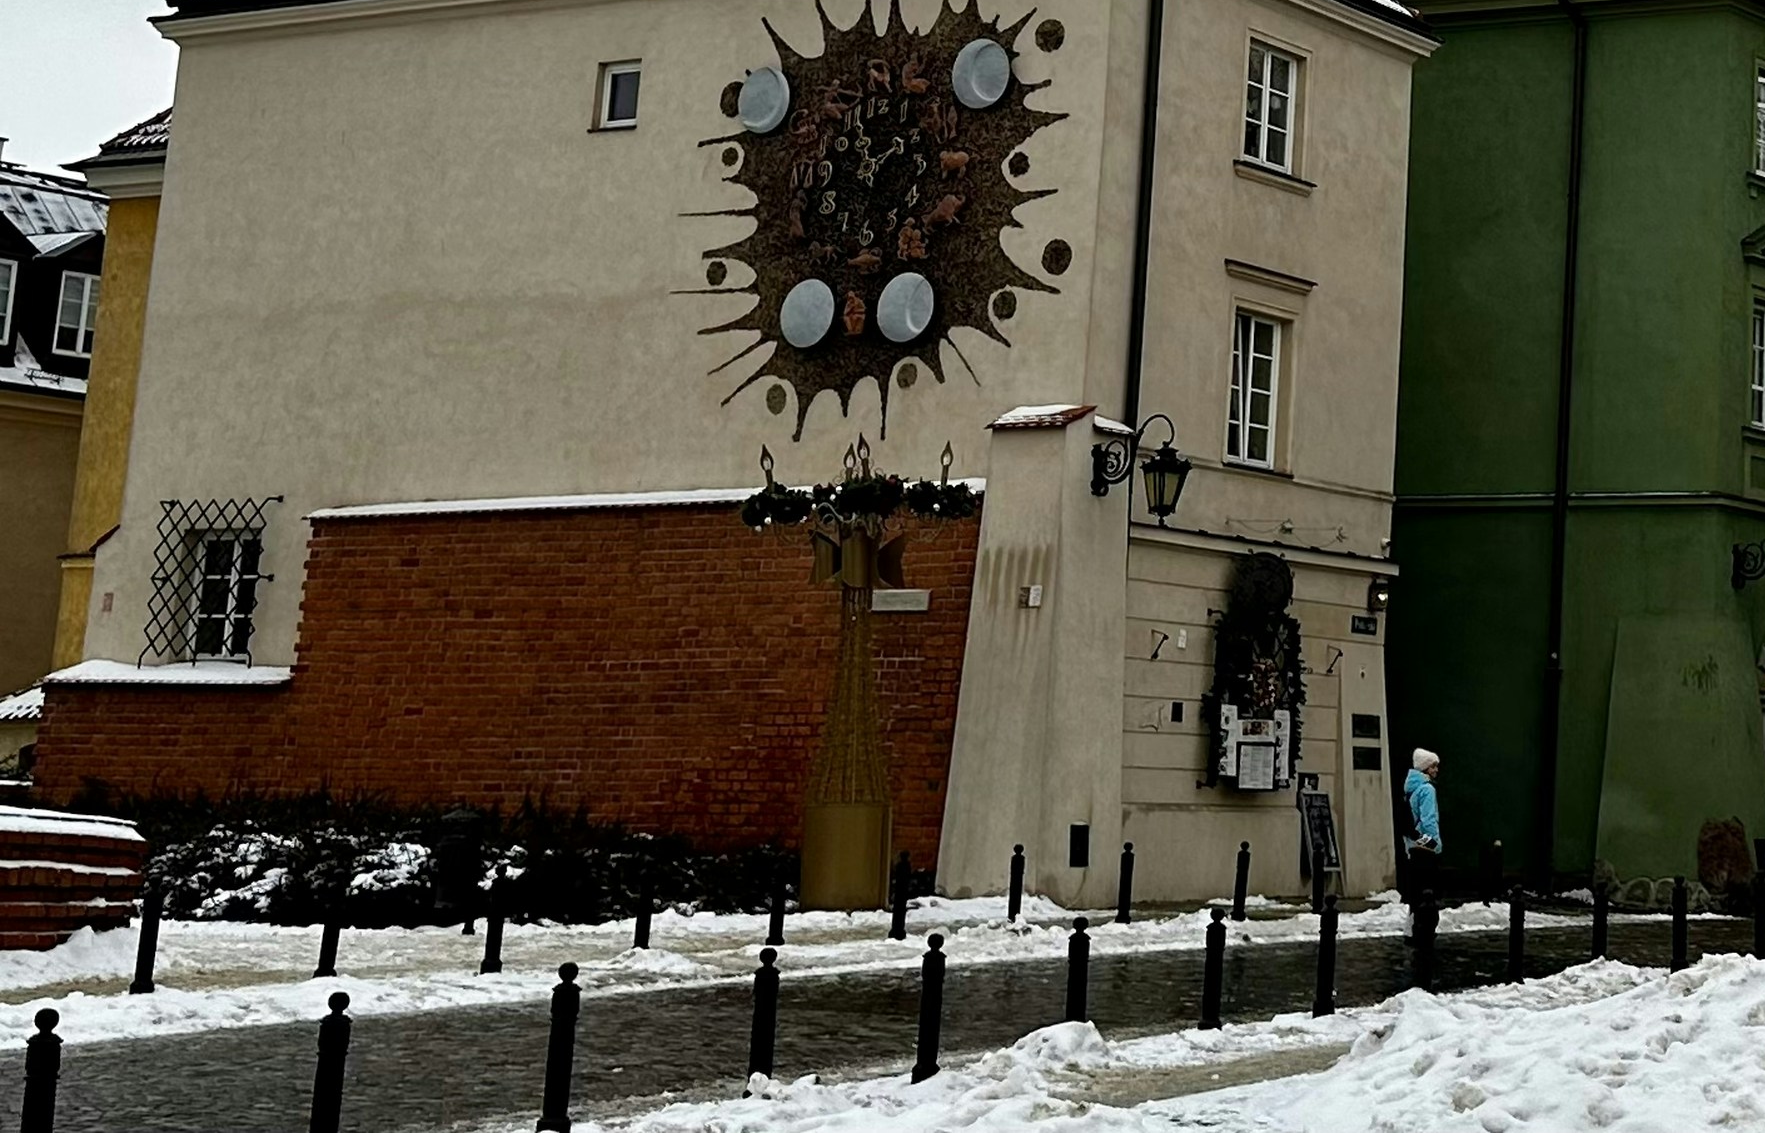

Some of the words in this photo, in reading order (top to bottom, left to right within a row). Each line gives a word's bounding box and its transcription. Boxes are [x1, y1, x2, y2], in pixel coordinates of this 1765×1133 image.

[866, 97, 890, 119] 12
[900, 98, 909, 124] 1
[818, 160, 833, 187] 9
[913, 153, 927, 176] 3
[818, 190, 836, 215] 8
[904, 183, 920, 209] 4
[838, 211, 849, 232] 7
[886, 207, 899, 232] 5
[858, 219, 875, 246] 6
